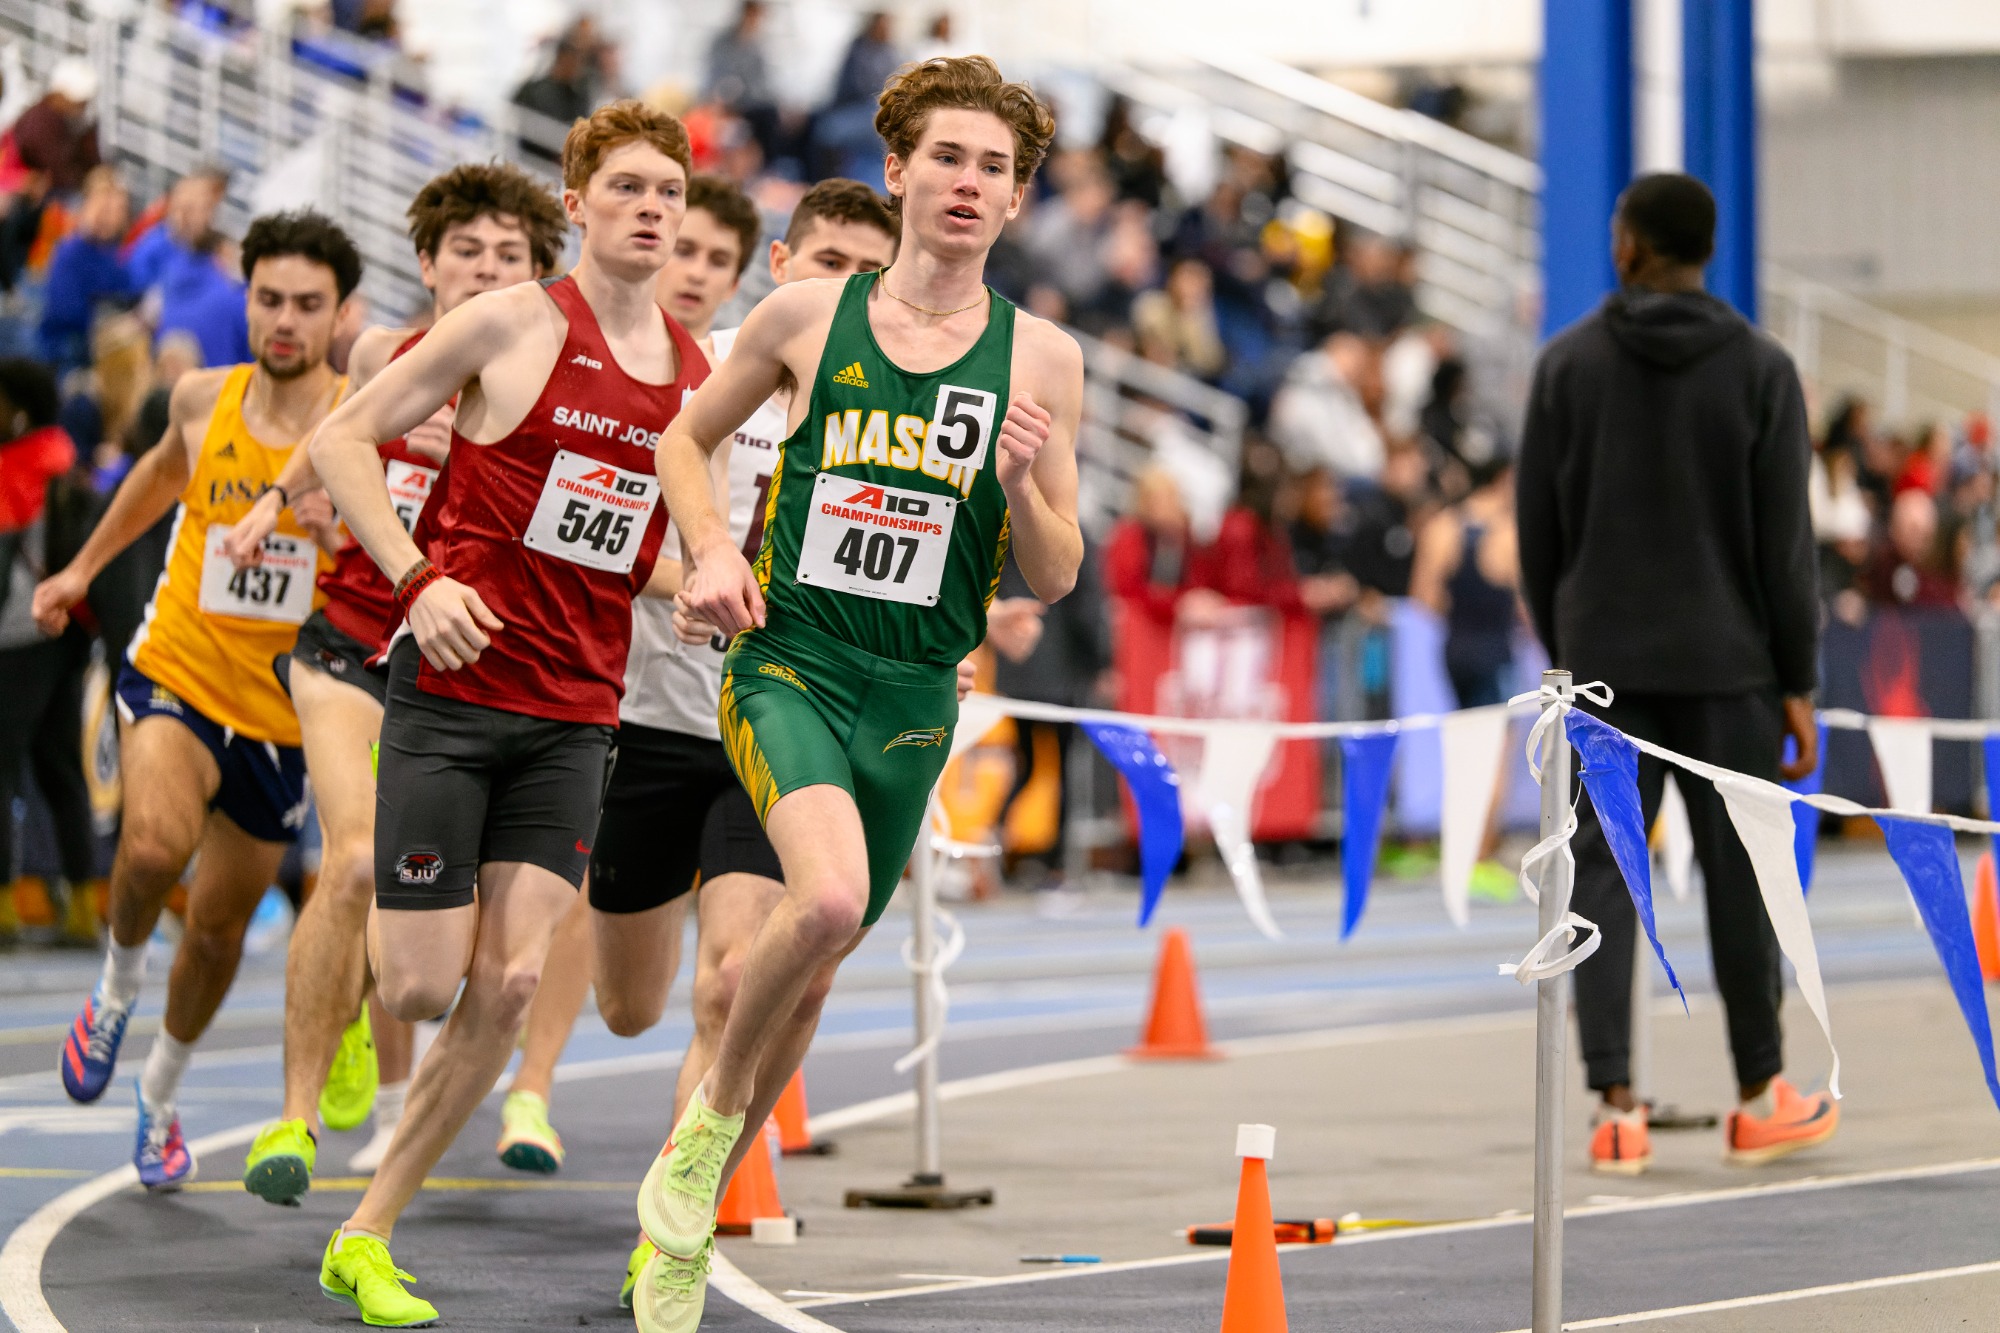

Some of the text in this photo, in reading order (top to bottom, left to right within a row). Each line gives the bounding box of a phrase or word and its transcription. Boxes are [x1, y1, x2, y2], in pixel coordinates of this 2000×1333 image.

[832, 375, 869, 389] adidas
[552, 406, 620, 438] SAINT
[936, 390, 985, 460] 5
[556, 477, 651, 512] CHAMPIONSHIPS
[577, 464, 648, 496] A10
[843, 484, 930, 517] A10
[557, 498, 634, 555] 545
[820, 502, 943, 536] CHAMPIONSHIPS
[833, 526, 920, 584] 407
[228, 566, 291, 606] 437
[758, 665, 807, 691] adidas
[401, 867, 435, 881] SJU
